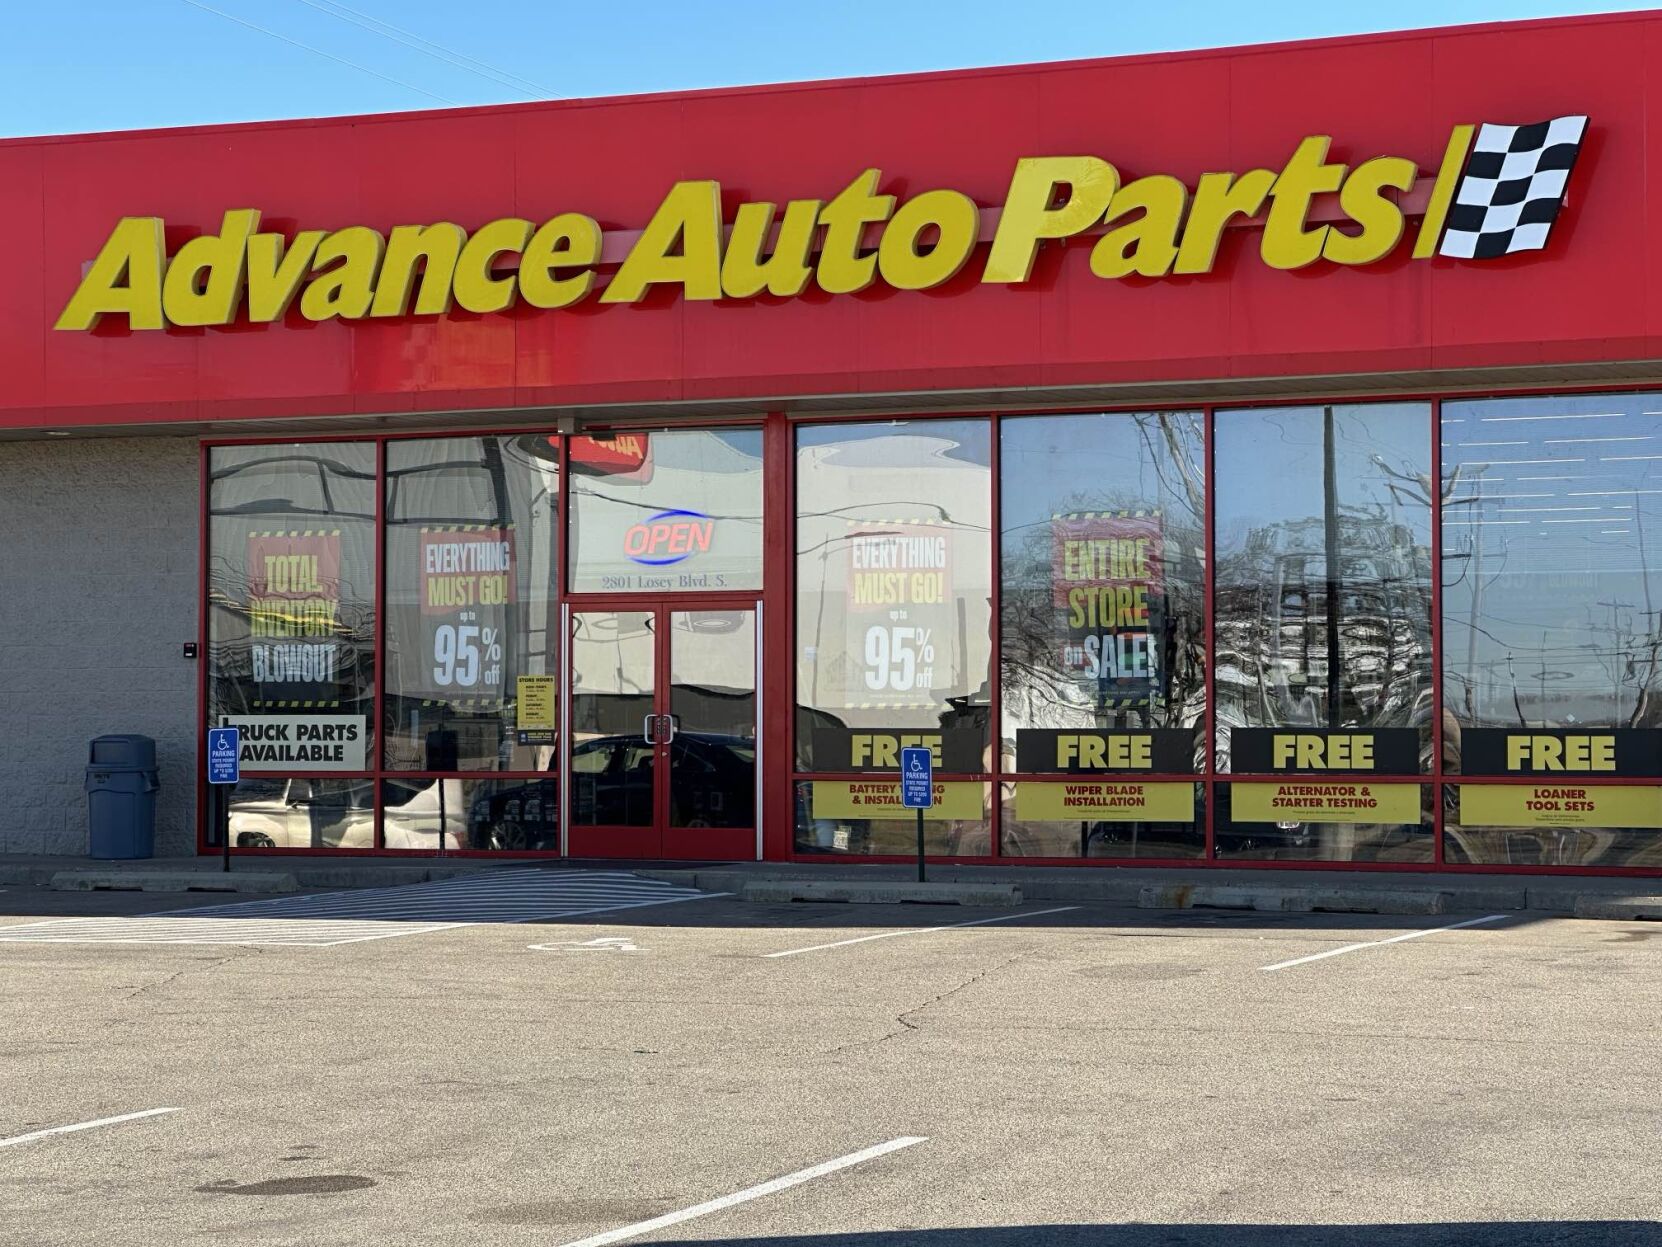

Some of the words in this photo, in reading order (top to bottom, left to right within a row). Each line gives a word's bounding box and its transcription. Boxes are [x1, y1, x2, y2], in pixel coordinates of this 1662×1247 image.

[54, 208, 603, 331] Advance
[600, 168, 980, 305] Auto
[982, 134, 1419, 285] Parts
[623, 520, 714, 556] OPEN
[426, 541, 510, 573] EVERYTHING
[852, 536, 946, 569] EVERYTHING
[1063, 538, 1150, 581] ENTIRE
[264, 555, 323, 593] TOTAL
[602, 575, 631, 589] 2801
[638, 574, 674, 590] Losey
[679, 573, 712, 588] Blvd.
[715, 574, 728, 588] S.
[428, 576, 476, 607] MUST
[479, 575, 508, 605] GO!
[854, 572, 907, 604] MUST
[910, 572, 943, 604] GO!
[890, 610, 899, 622] up
[900, 609, 908, 620] to
[1068, 585, 1150, 629] STORE
[252, 644, 336, 682] BLOWOUT
[1064, 645, 1083, 666] on
[1084, 633, 1156, 679] SALE!
[484, 665, 500, 685] off
[916, 666, 933, 688] off
[226, 724, 290, 741] RUCK
[296, 724, 358, 741] PARTS
[239, 744, 344, 762] AVAILABLE
[1057, 735, 1152, 769] FREE
[1273, 735, 1374, 769] FREE
[1507, 735, 1616, 771] FREE
[906, 772, 928, 780] PARKING
[850, 784, 896, 794] BATTERY
[1066, 786, 1103, 795] WIPER
[1106, 786, 1143, 795] BLADE
[1278, 786, 1356, 796] ALTERNATOR
[1361, 787, 1370, 797] &
[1534, 789, 1586, 799] LOANER
[852, 796, 862, 805] &
[1063, 797, 1145, 807] INSTALLATION
[1272, 798, 1323, 808] STARTER
[1326, 798, 1378, 808] TESTING
[1526, 801, 1561, 811] TOOL
[1565, 801, 1595, 811] SETS
